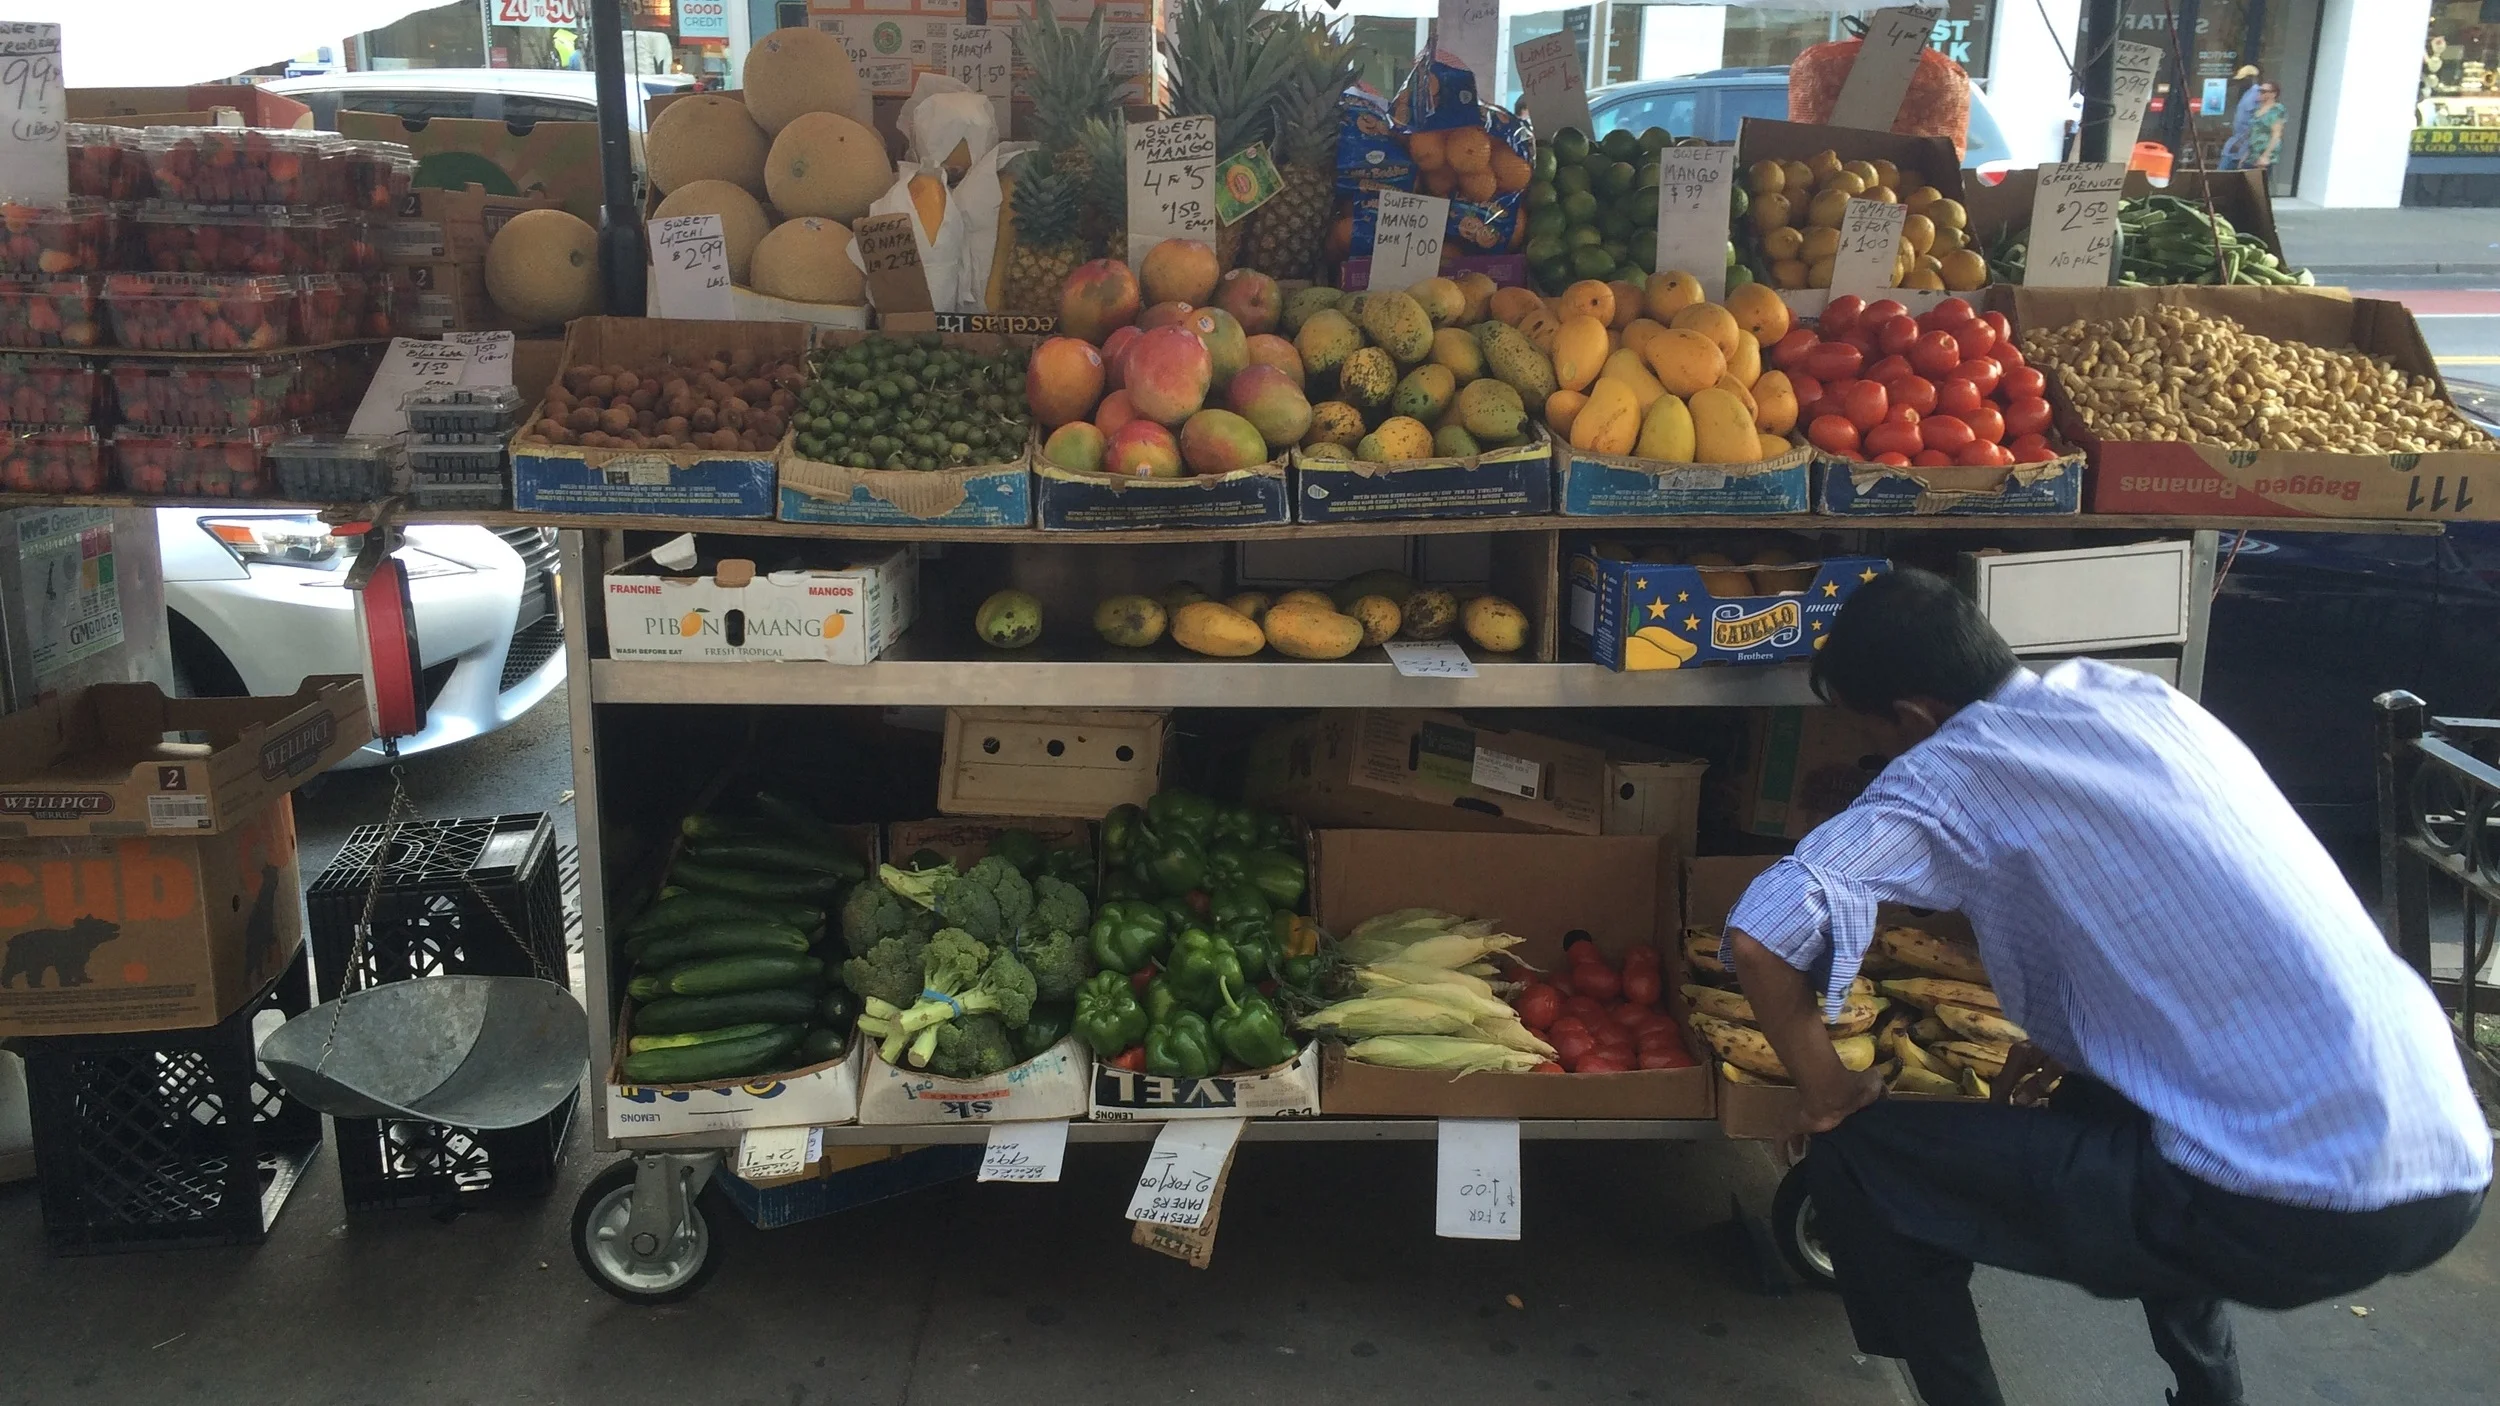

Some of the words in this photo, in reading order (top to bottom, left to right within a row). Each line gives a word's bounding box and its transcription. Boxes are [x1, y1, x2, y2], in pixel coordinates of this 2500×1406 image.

[684, 4, 722, 15] GOOD
[684, 16, 723, 27] CREDIT
[953, 29, 991, 41] SWEET
[1520, 40, 1562, 63] LIMES
[1145, 118, 1207, 138] SWEET
[1135, 133, 1206, 151] MEXICAN
[1147, 140, 1214, 160] MANGO
[1673, 148, 1729, 163] SWEET
[1664, 164, 1719, 183] MANGO
[2056, 163, 2104, 175] FRESH
[1144, 169, 1162, 196] 4
[2042, 174, 2083, 186] GREEN
[1383, 194, 1429, 210] SWEET
[664, 216, 714, 232] SWEET
[862, 218, 907, 236] SWEET
[1381, 214, 1429, 229] MANGO
[1865, 221, 1892, 234] FOR
[1377, 233, 1400, 245] EACH
[1401, 232, 1437, 267] 1.00
[2120, 475, 2238, 500] Bananas
[2254, 478, 2361, 501] Bagged
[2406, 475, 2474, 512] 111
[52, 511, 84, 531] Green
[610, 584, 662, 595] FRANCINE
[809, 586, 854, 597] MANGOS
[1716, 605, 1795, 645] CABELLO
[705, 648, 736, 657] FRESH
[737, 648, 785, 657] TROPICAL
[1737, 651, 1774, 661] Brothers
[167, 769, 180, 788] 2
[36, 810, 78, 820] BERRIES
[621, 1113, 661, 1123] LEMONS
[1095, 1110, 1134, 1120] LEMONS
[1168, 1174, 1192, 1191] FOR
[1192, 1170, 1212, 1193] 2
[1152, 1197, 1205, 1211] PAPERS
[1134, 1207, 1156, 1221] RED
[1160, 1212, 1200, 1225] FRESH
[1468, 1208, 1492, 1224] FOR
[1499, 1211, 1507, 1224] 2
